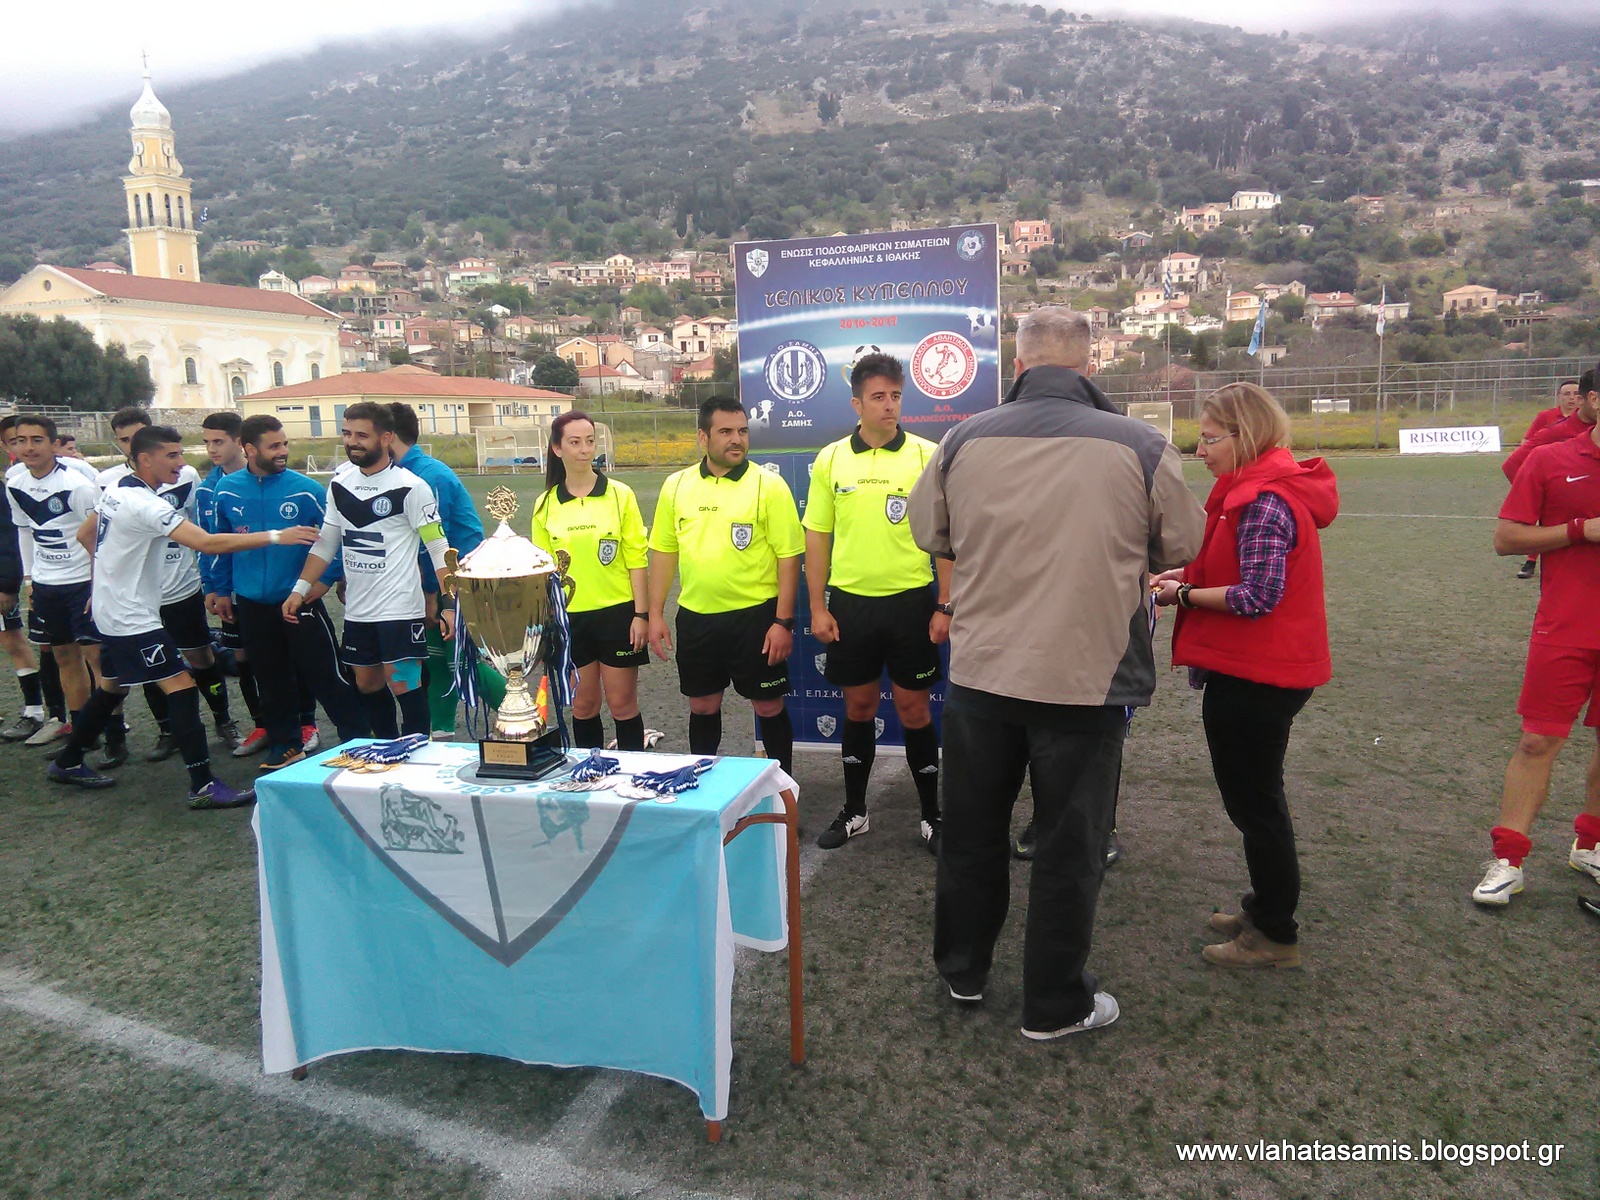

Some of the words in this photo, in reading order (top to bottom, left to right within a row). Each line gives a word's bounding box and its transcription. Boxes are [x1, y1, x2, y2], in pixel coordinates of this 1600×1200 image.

[781, 248, 814, 258] ΕΝΩΣΙΣ
[816, 242, 892, 256] ΠΟΔΟΣΦΑΙΡΙΚΩΝ
[894, 238, 950, 250] ΣΩΜΑΤΕΙΩΝ
[809, 254, 874, 268] ΚΕΦΑΛΛΗΝΙΑΣ
[876, 253, 884, 262] &
[886, 251, 920, 262] ΙΘΑΚΗΣ
[852, 278, 968, 302] ΚΥΠΕΛΛΟΥ
[840, 316, 898, 330] 2016-2017
[782, 419, 813, 428] ΣΑΜΗΣ
